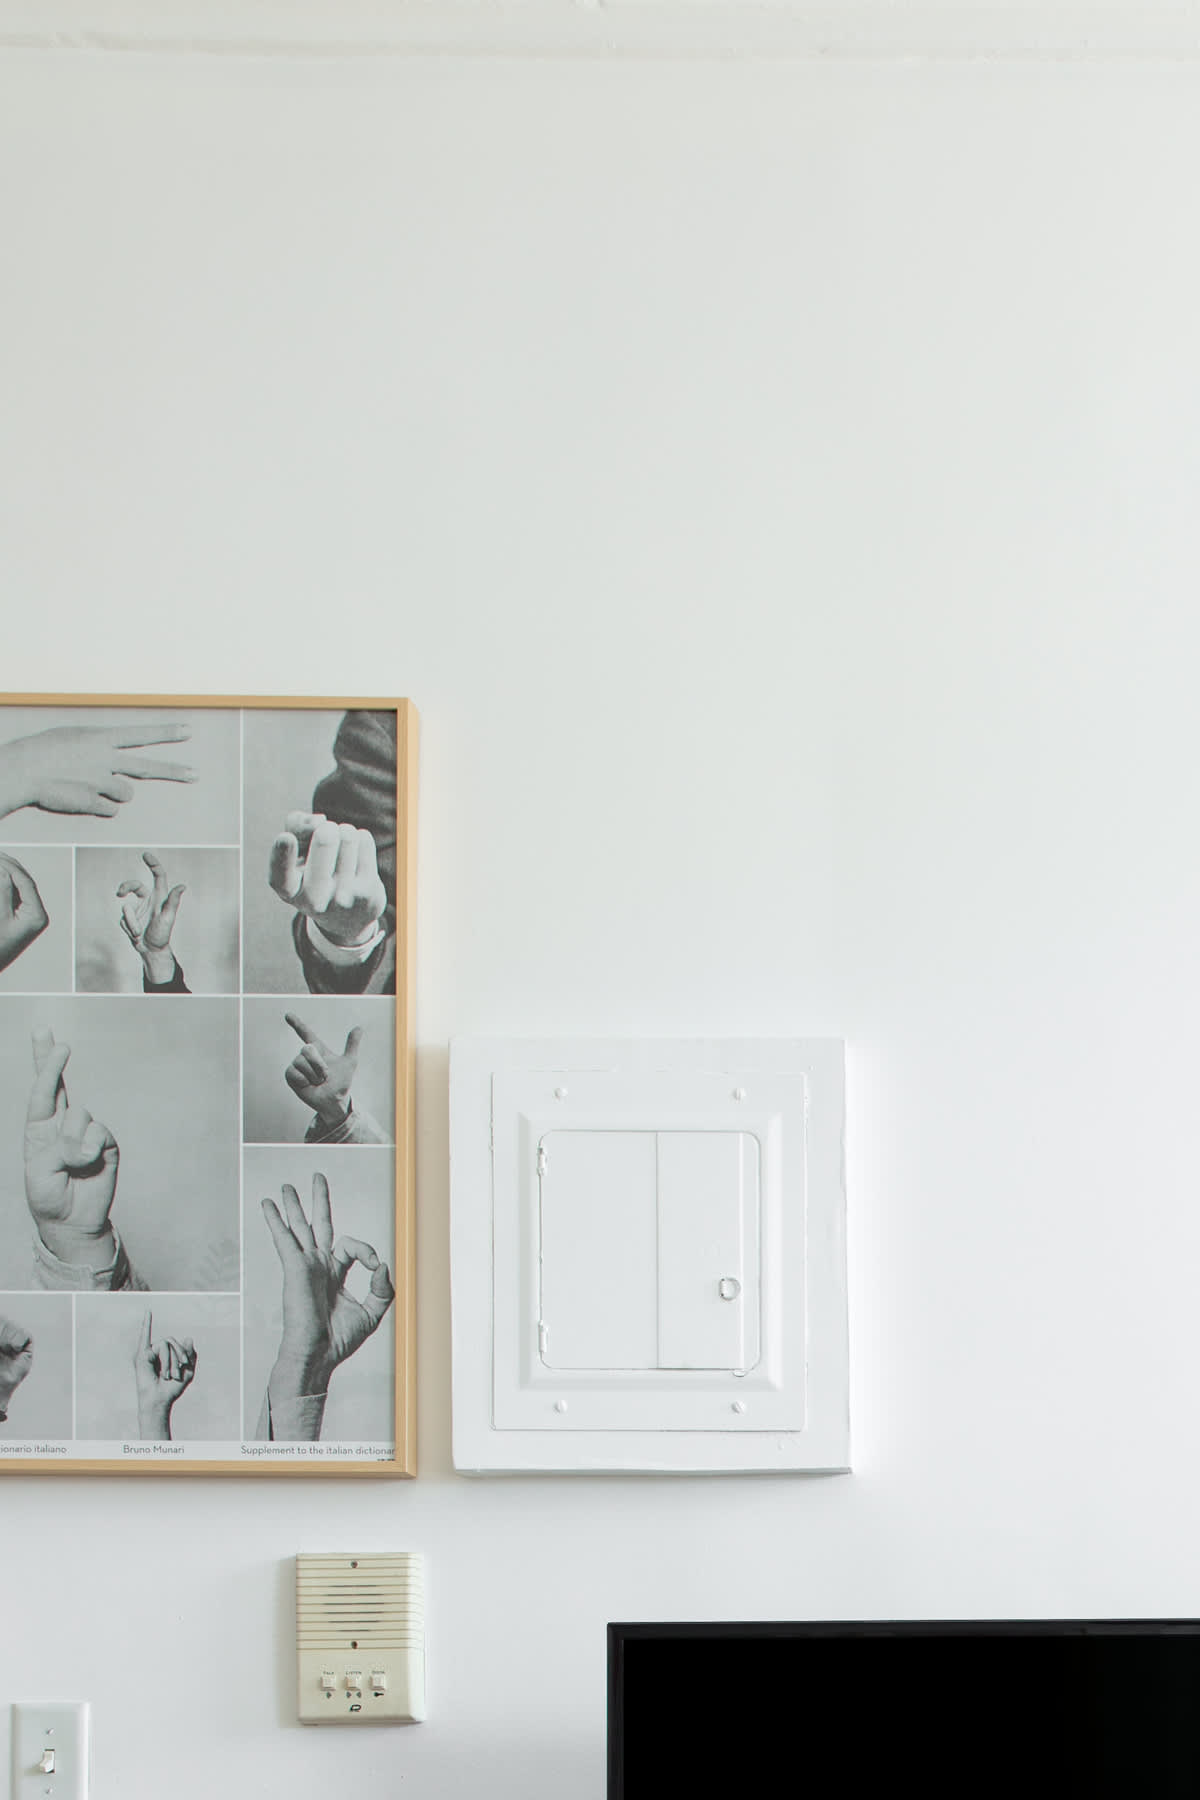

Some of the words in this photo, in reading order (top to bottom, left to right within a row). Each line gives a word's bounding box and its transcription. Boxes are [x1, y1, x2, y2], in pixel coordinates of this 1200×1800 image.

[0, 1444, 32, 1454] ionario
[34, 1444, 67, 1454] italiano
[123, 1445, 150, 1454] Bruno
[153, 1445, 184, 1454] Munari
[241, 1445, 295, 1456] Supplement
[297, 1446, 306, 1455] to
[309, 1445, 324, 1455] the
[326, 1446, 352, 1455] italian
[355, 1446, 395, 1455] dictionar
